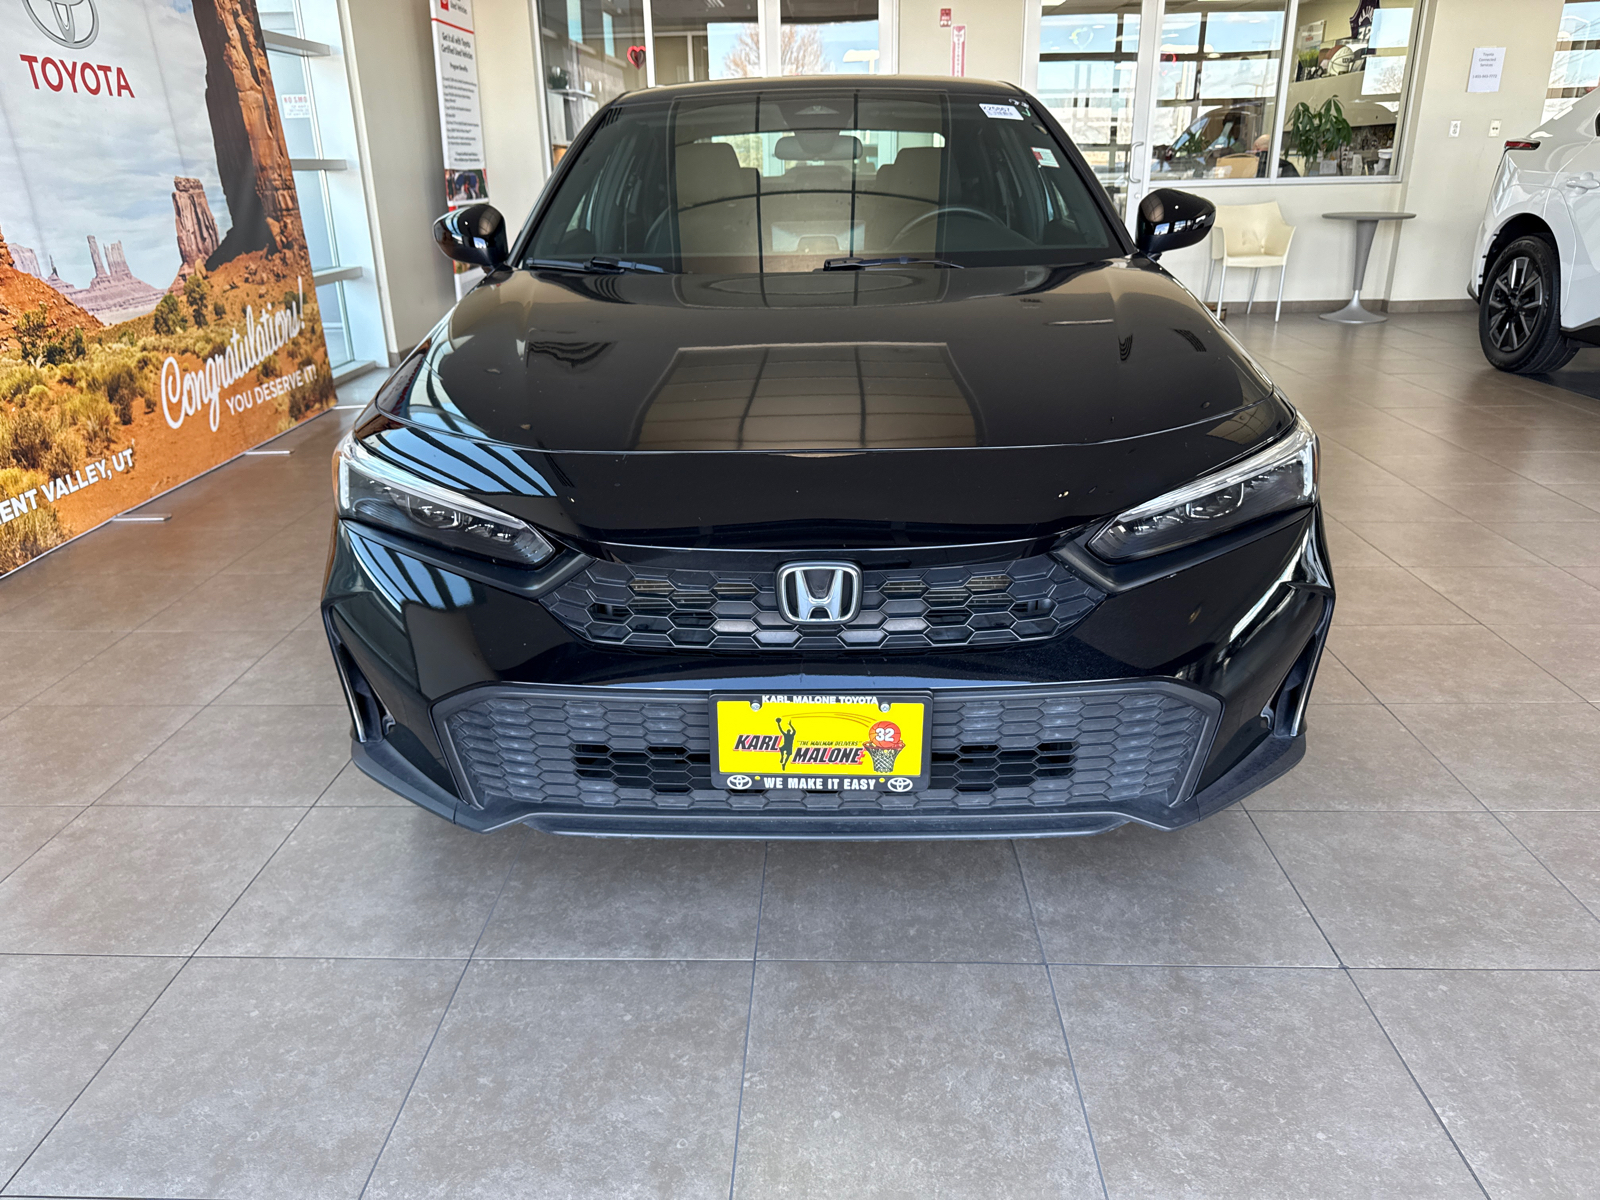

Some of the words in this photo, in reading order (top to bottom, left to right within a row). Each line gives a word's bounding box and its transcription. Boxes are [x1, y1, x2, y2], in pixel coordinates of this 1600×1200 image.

[19, 54, 135, 98] TOYOTA
[161, 275, 305, 432] Congratulations!
[225, 390, 253, 416] YOU
[253, 369, 304, 405] DESERVE
[303, 364, 318, 384] IT!
[0, 488, 38, 525] ENT
[40, 459, 113, 503] VALLEY,
[111, 448, 133, 472] UT
[762, 695, 791, 703] KARL
[792, 696, 837, 704] MALONE
[838, 696, 879, 705] TOYOTA
[734, 734, 783, 752] KARL
[875, 727, 895, 742] 32
[791, 747, 865, 765] MALONE
[763, 777, 784, 788] WE
[787, 777, 823, 789] MAKE
[827, 778, 839, 789] IT
[843, 778, 876, 790] EASY
